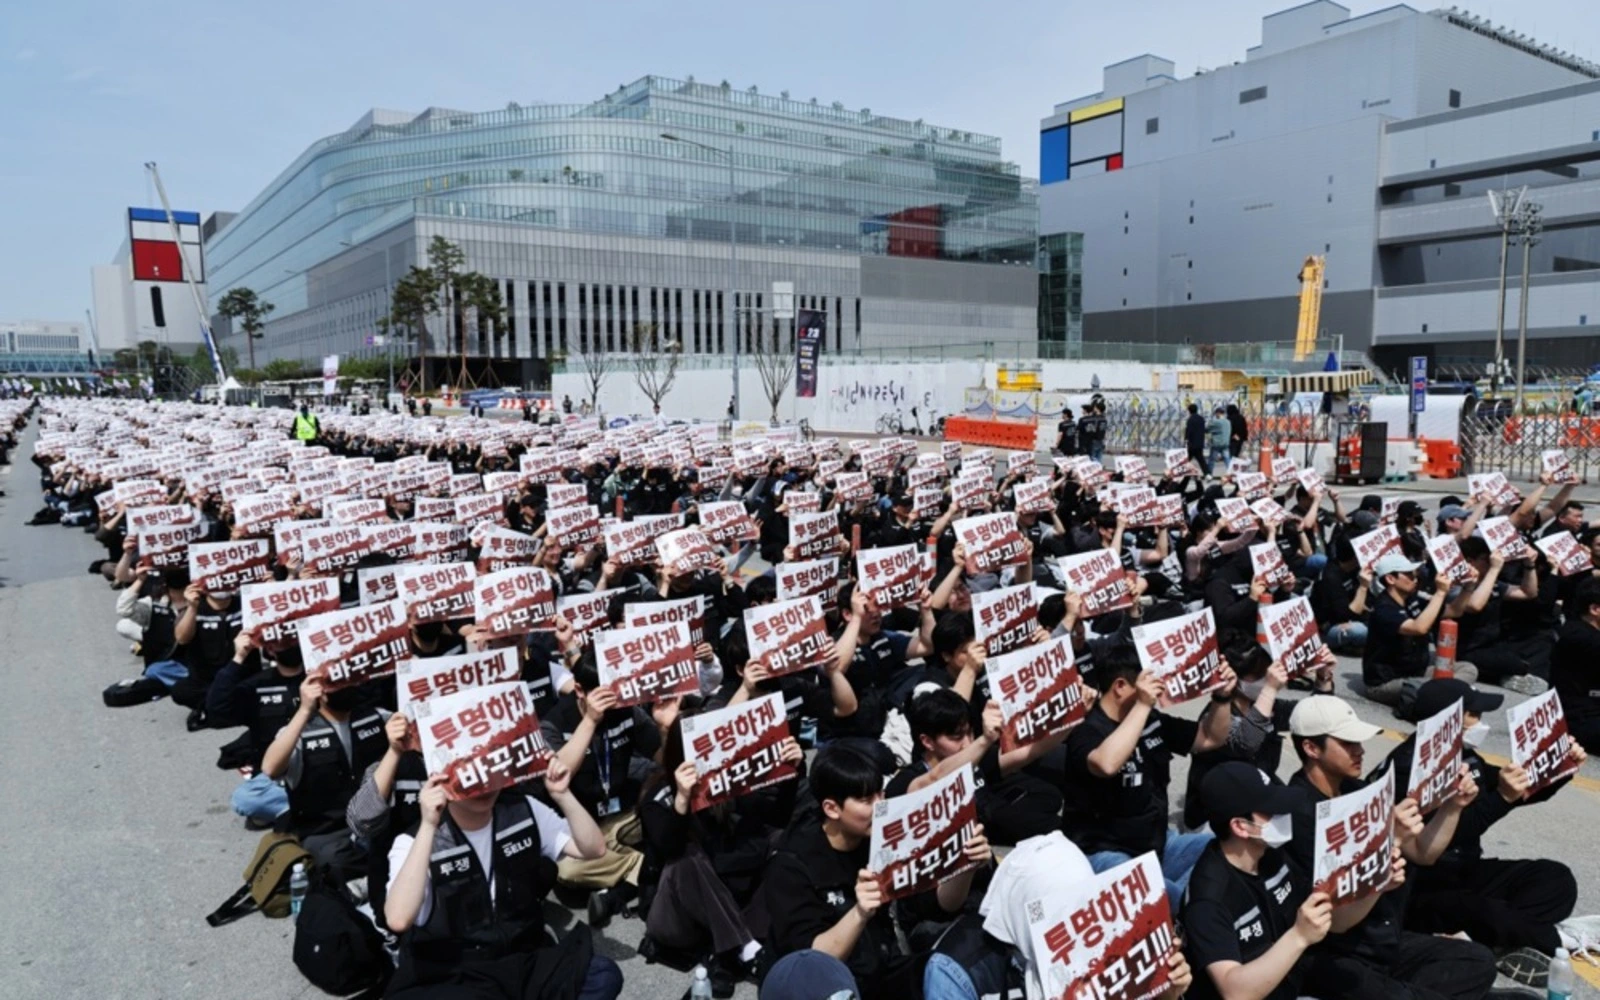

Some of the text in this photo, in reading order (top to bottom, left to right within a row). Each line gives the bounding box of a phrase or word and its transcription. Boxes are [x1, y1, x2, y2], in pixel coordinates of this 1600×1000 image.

[551, 507, 593, 530] 투명하게
[703, 503, 745, 525] 투명하게
[794, 513, 836, 539] 투명하게
[962, 515, 1014, 546] 투명하게
[196, 541, 259, 569] 투명하게
[308, 527, 361, 552] 투명하게
[404, 565, 468, 596] 투명하게
[782, 560, 835, 592] 투명하게
[864, 547, 917, 581] 투명하게
[1068, 551, 1115, 587] 투명하게
[250, 581, 329, 616] 투명하게
[416, 591, 476, 619] 바꾸고!!!
[480, 571, 546, 606] 투명하게
[980, 585, 1032, 628] 투명하게
[309, 604, 396, 653] 투명하게
[492, 600, 555, 632] 바꾸고!!!
[752, 599, 816, 643] 투명하게
[988, 616, 1038, 655] 바꾸고!!!
[1270, 600, 1309, 644] 투명하게
[327, 636, 410, 682] 바꾸고!!!
[605, 625, 681, 670] 투명하게
[768, 631, 829, 670] 바꾸고!!!
[1146, 612, 1211, 665] 투명하게
[408, 652, 507, 702] 투명하게
[619, 658, 696, 700] 바꾸고!!!
[999, 641, 1067, 703] 투명하게
[1165, 649, 1220, 698] 바꾸고!!!
[430, 685, 528, 750] 투명하게
[692, 698, 777, 762] 투명하게
[1015, 682, 1082, 740] 바꾸고!!!
[1514, 694, 1560, 753] 투명하게
[455, 729, 549, 789] 바꾸고!!!
[1419, 707, 1461, 770] 투명하게
[882, 772, 967, 851] 투명하게
[440, 856, 471, 876] 투쟁
[503, 837, 533, 858] SELU
[1043, 862, 1151, 966] 투명하게
